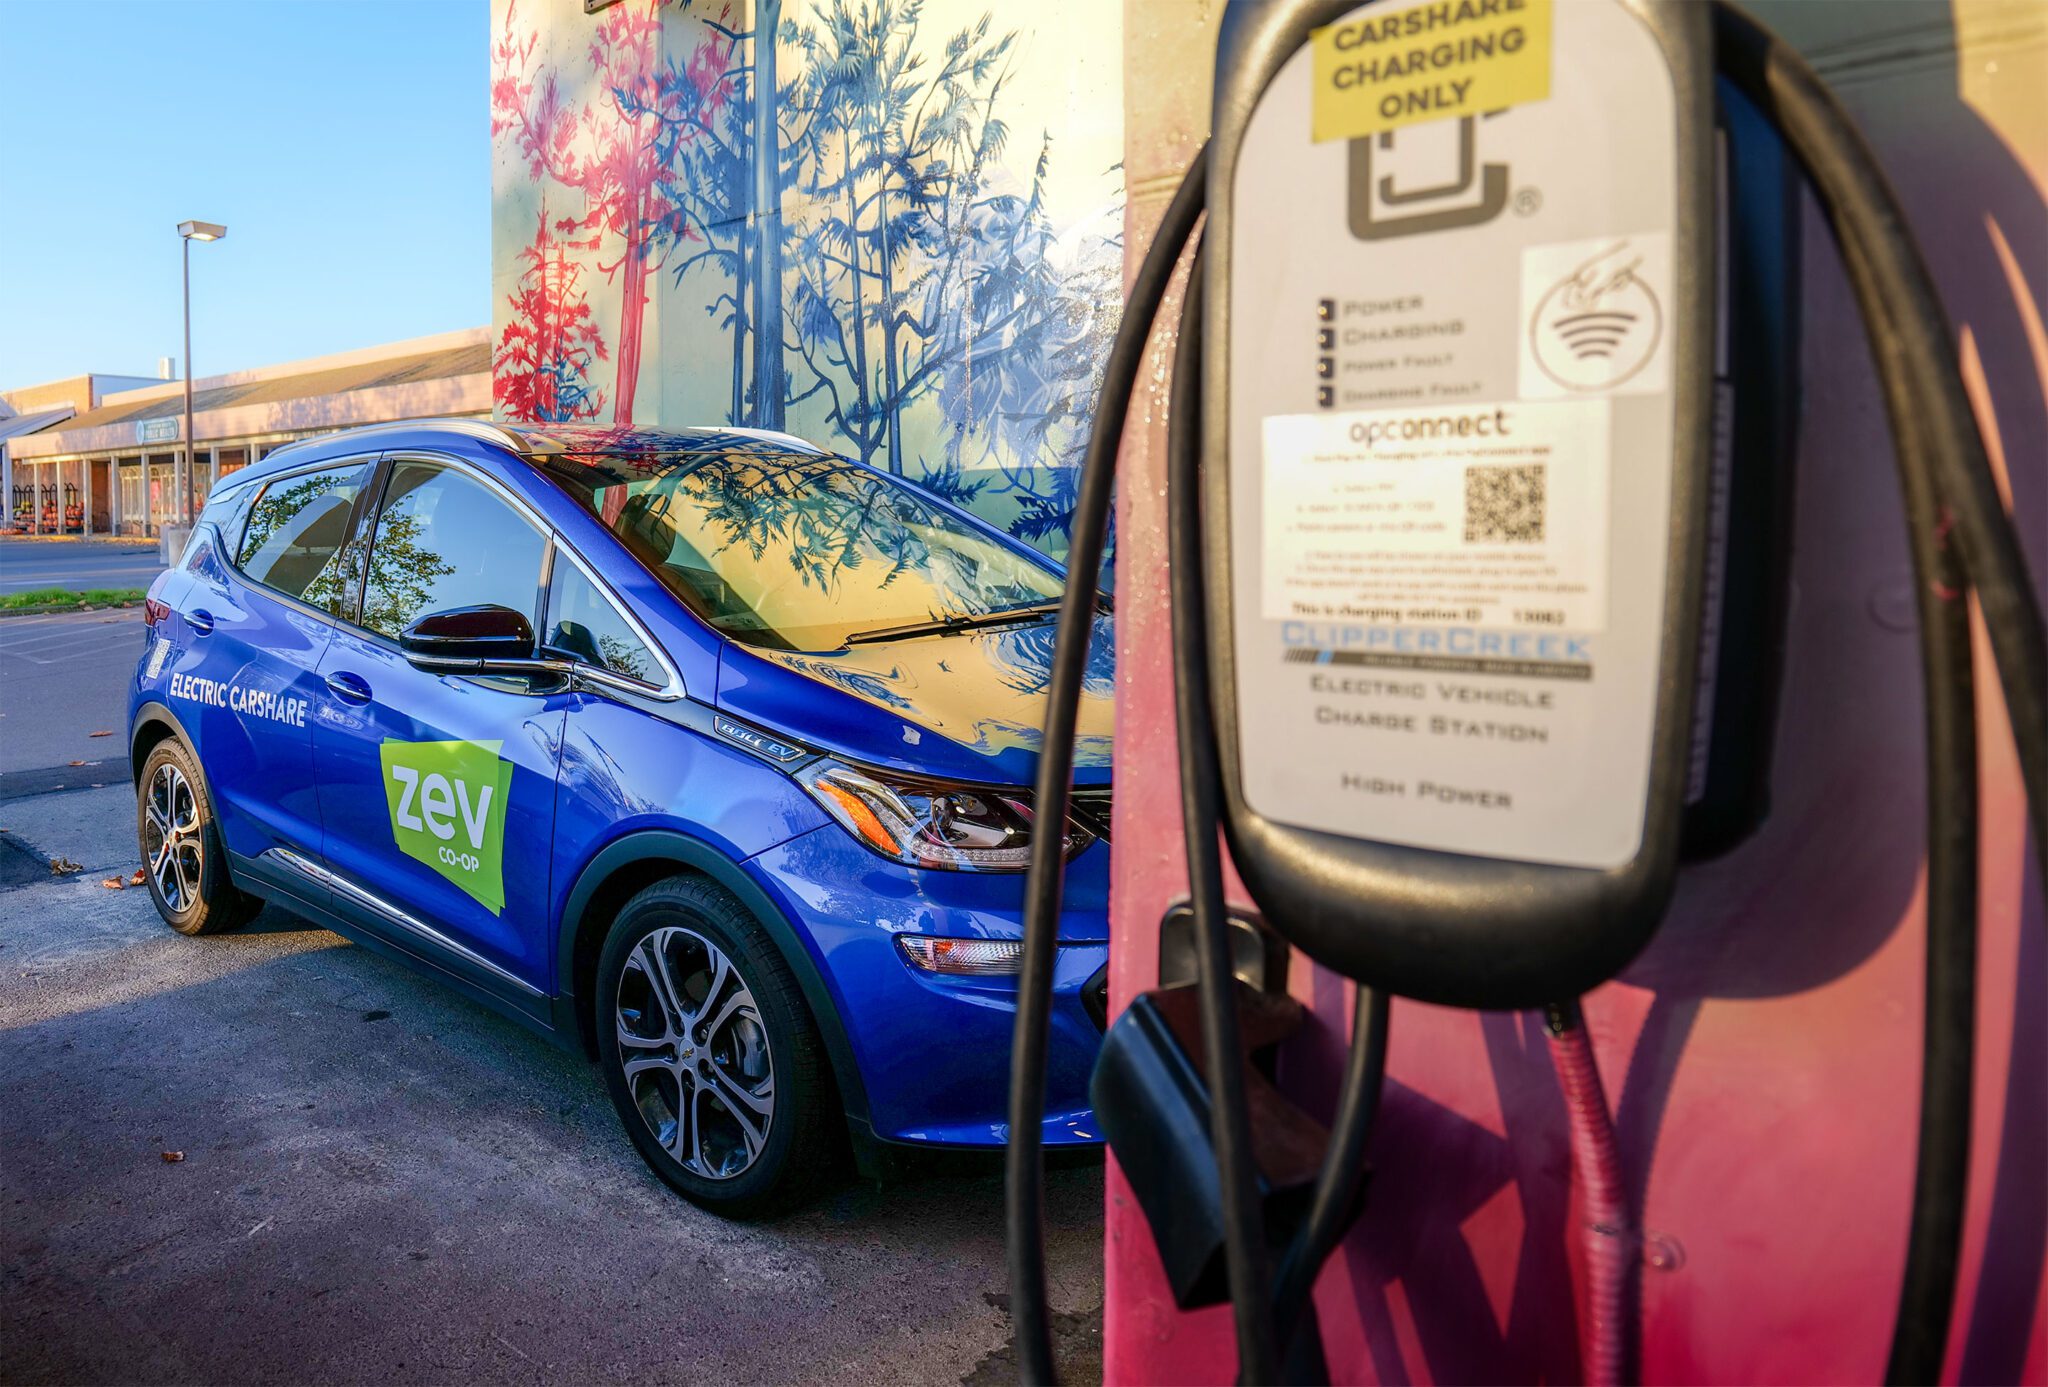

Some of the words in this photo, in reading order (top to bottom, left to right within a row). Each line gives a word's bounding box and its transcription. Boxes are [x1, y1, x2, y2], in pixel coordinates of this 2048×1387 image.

[1333, 27, 1526, 90] CHARGING
[1379, 77, 1473, 119] ONLY
[1350, 410, 1513, 448] opconnect
[1339, 605, 1401, 622] charging
[170, 672, 227, 707] ELECTRIC
[229, 685, 307, 728] CARSHARE
[768, 744, 795, 756] EV
[438, 845, 480, 873] CO-OP
